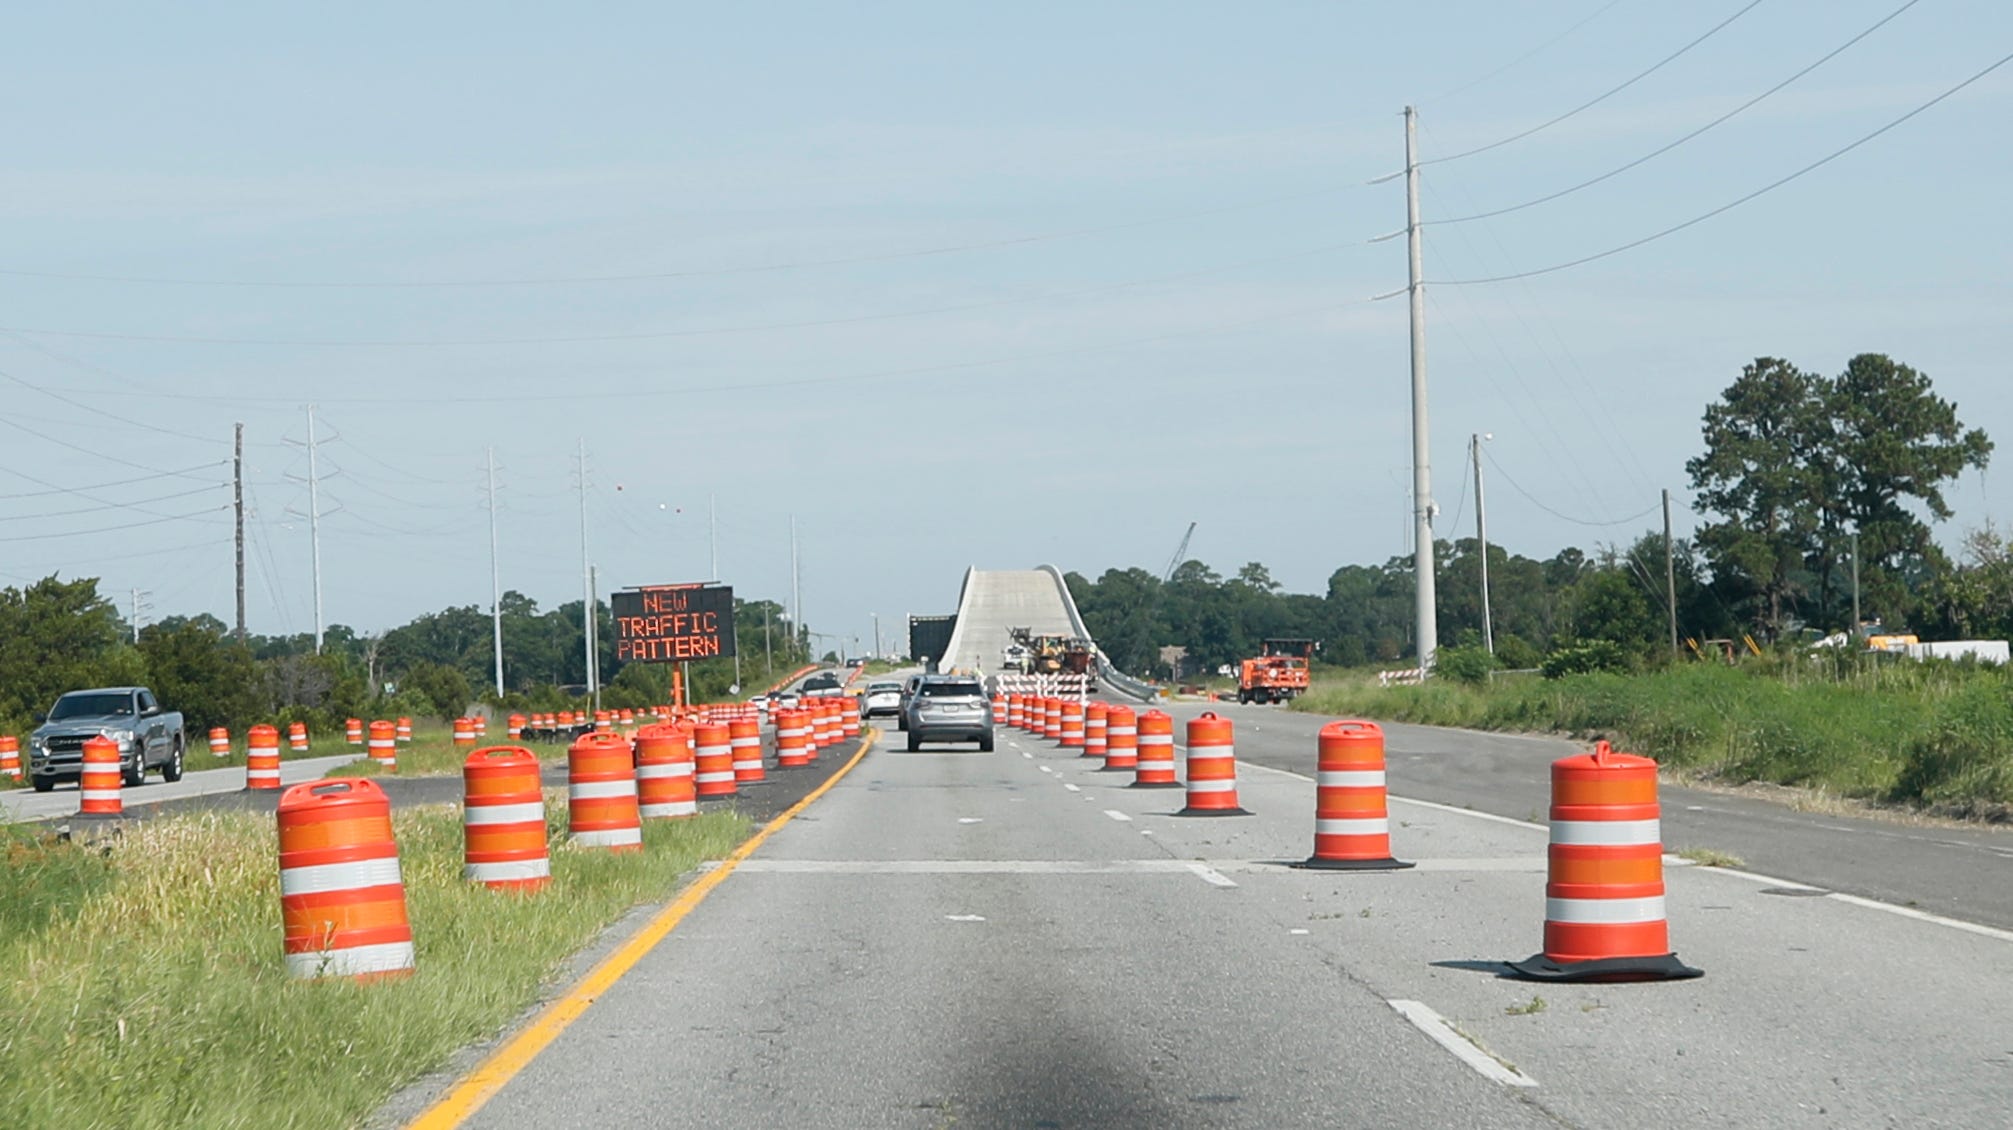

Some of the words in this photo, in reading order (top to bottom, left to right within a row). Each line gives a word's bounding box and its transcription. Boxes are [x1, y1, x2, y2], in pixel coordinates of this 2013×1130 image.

[643, 592, 688, 613] NEW
[617, 612, 718, 637] TRAFFIC
[618, 635, 719, 660] PATTERN
